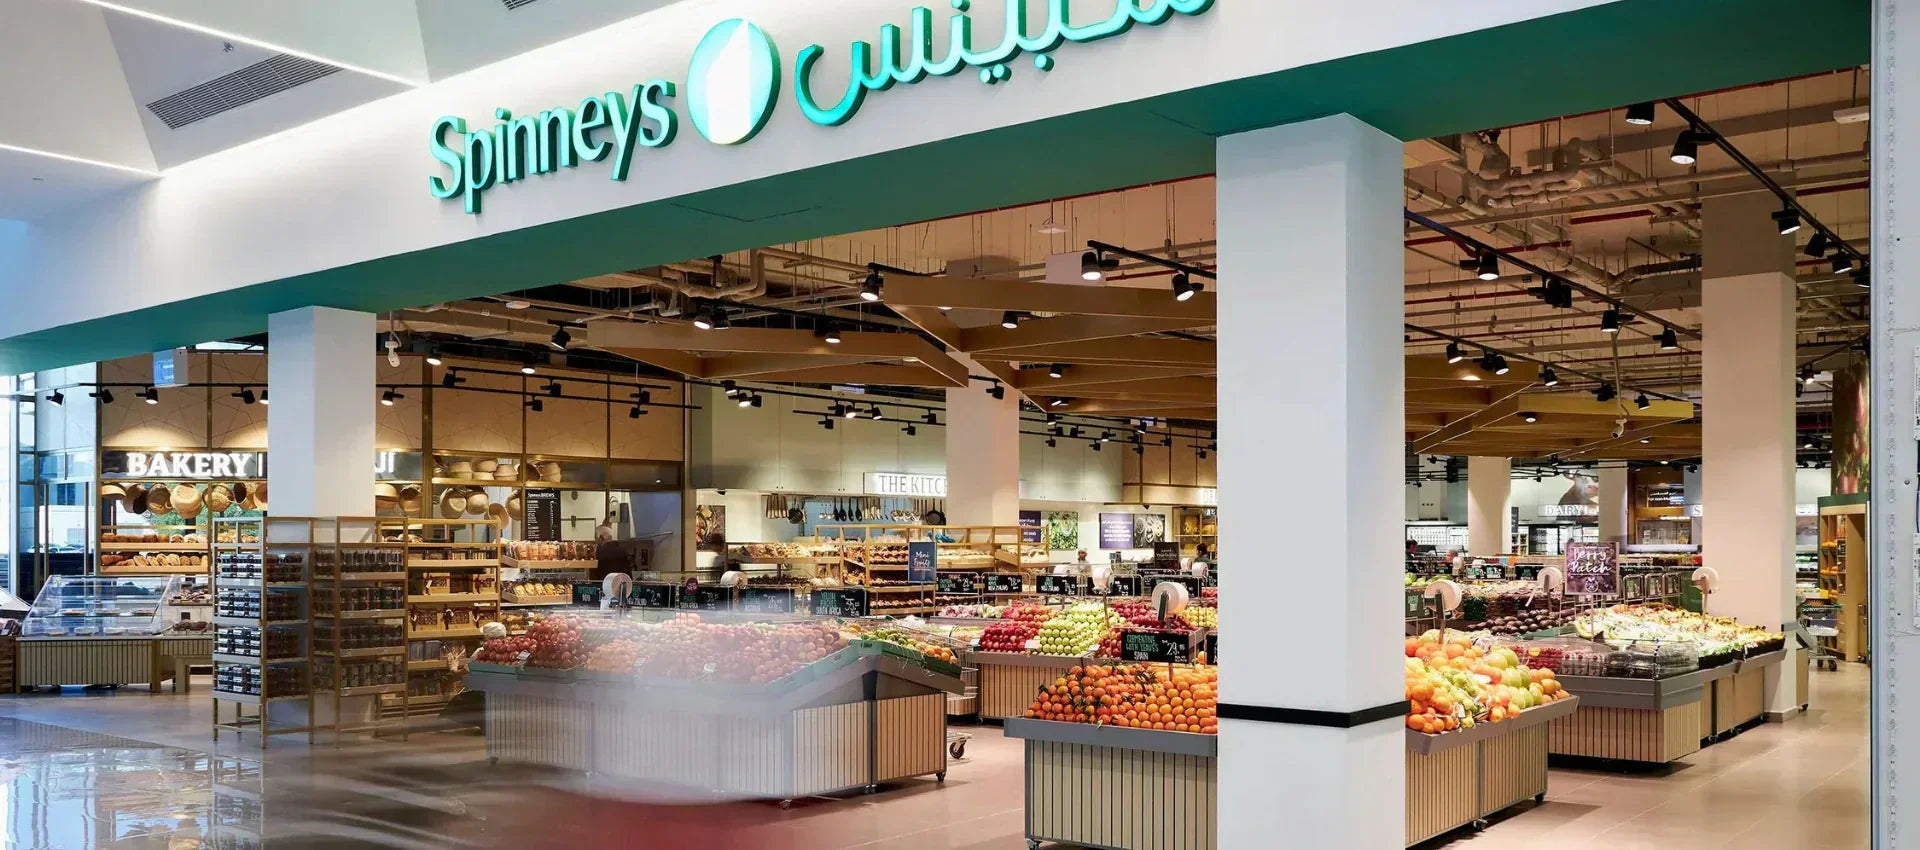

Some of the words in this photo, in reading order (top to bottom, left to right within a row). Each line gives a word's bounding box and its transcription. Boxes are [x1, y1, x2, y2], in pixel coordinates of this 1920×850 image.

[429, 79, 677, 215] Spinneys
[126, 452, 253, 478] BAKERY
[879, 475, 907, 493] THE
[1545, 505, 1582, 516] DAIRY
[1570, 560, 1612, 574] Patch
[1133, 651, 1149, 660] SPAIN
